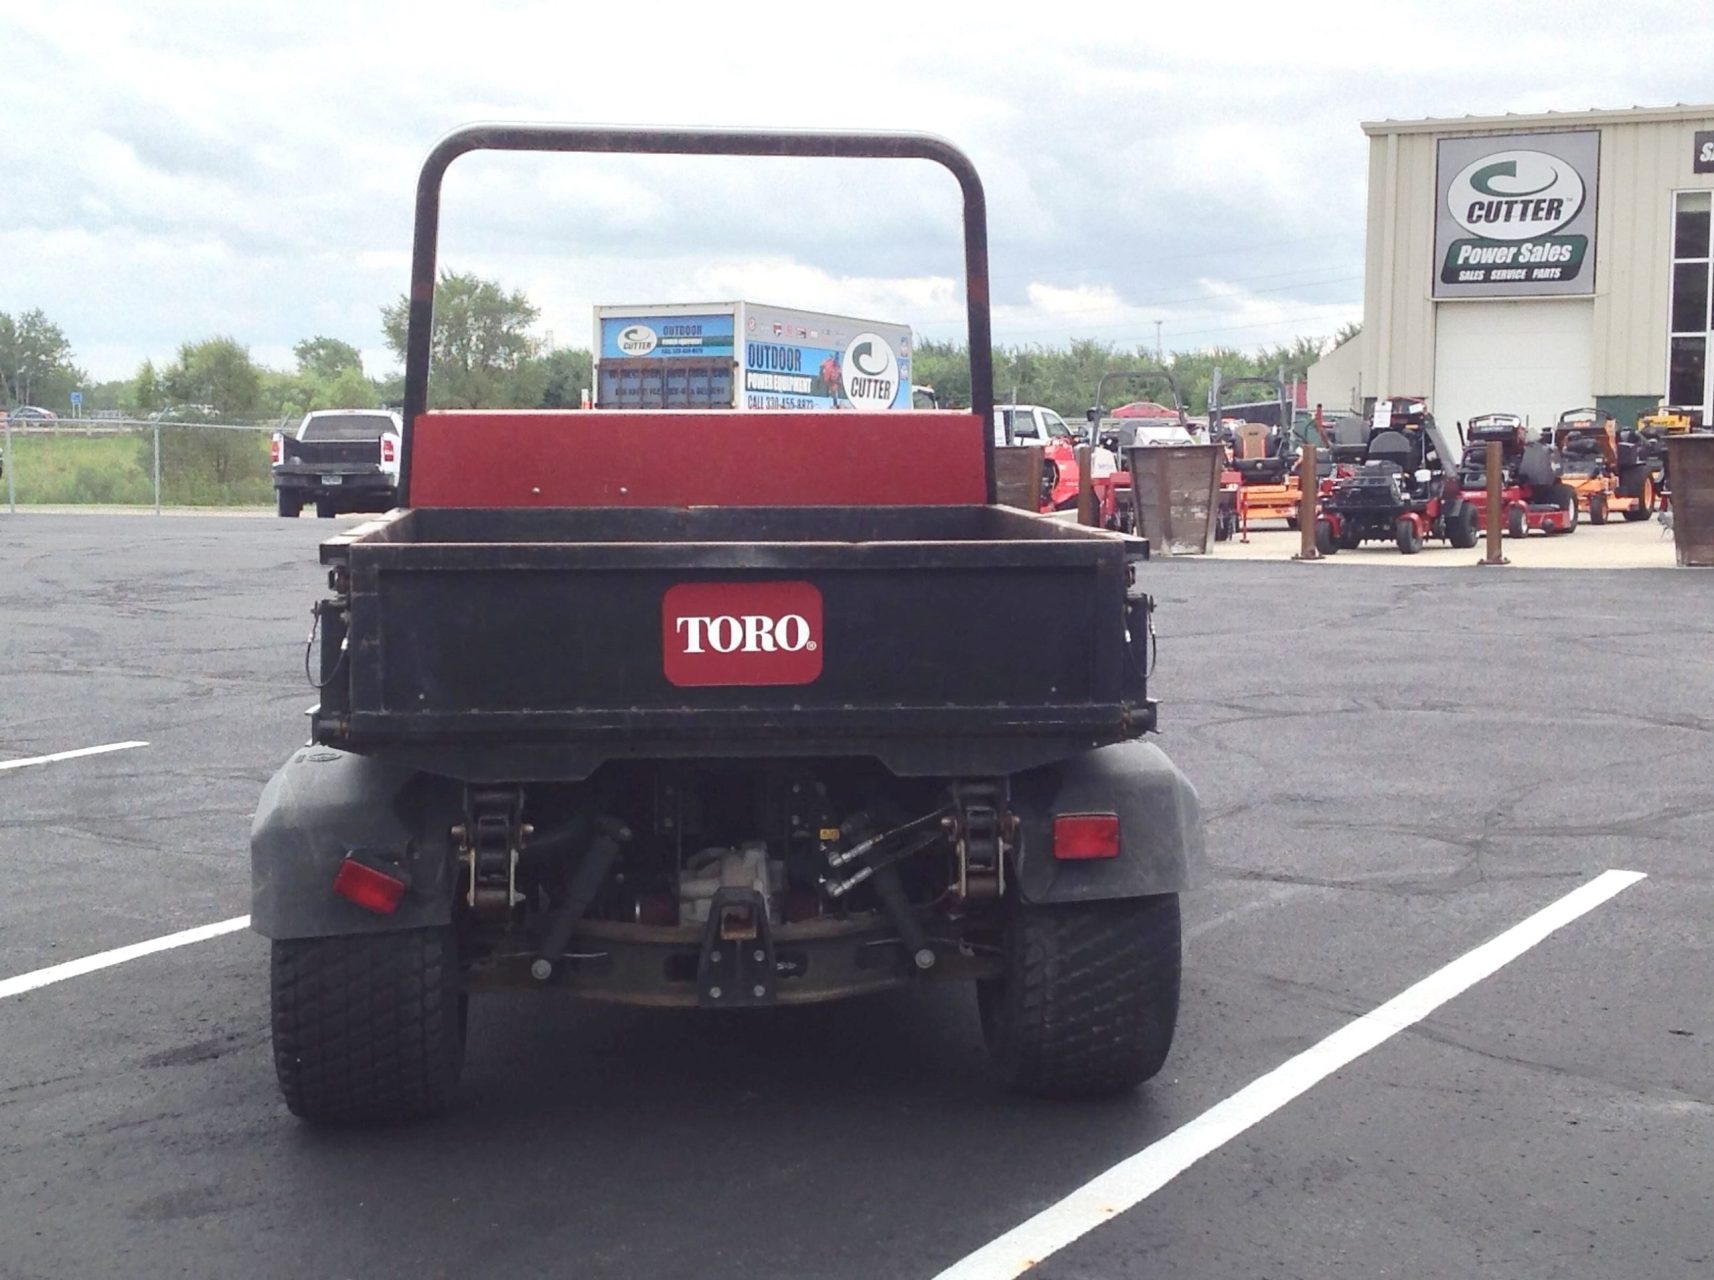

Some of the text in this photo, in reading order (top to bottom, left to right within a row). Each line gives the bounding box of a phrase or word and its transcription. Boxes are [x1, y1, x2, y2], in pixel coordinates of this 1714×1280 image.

[1700, 142, 1714, 162] S
[1466, 198, 1564, 224] CUTTER
[1457, 242, 1573, 265] Power Sales
[1458, 267, 1562, 281] SALES SERVICE PARTS
[623, 341, 652, 351] CUTTER
[748, 343, 802, 372] OUTDOOR
[747, 372, 774, 391] POWER
[850, 376, 891, 400] CUTTER
[747, 394, 764, 410] CALL
[676, 614, 811, 653] TORO
